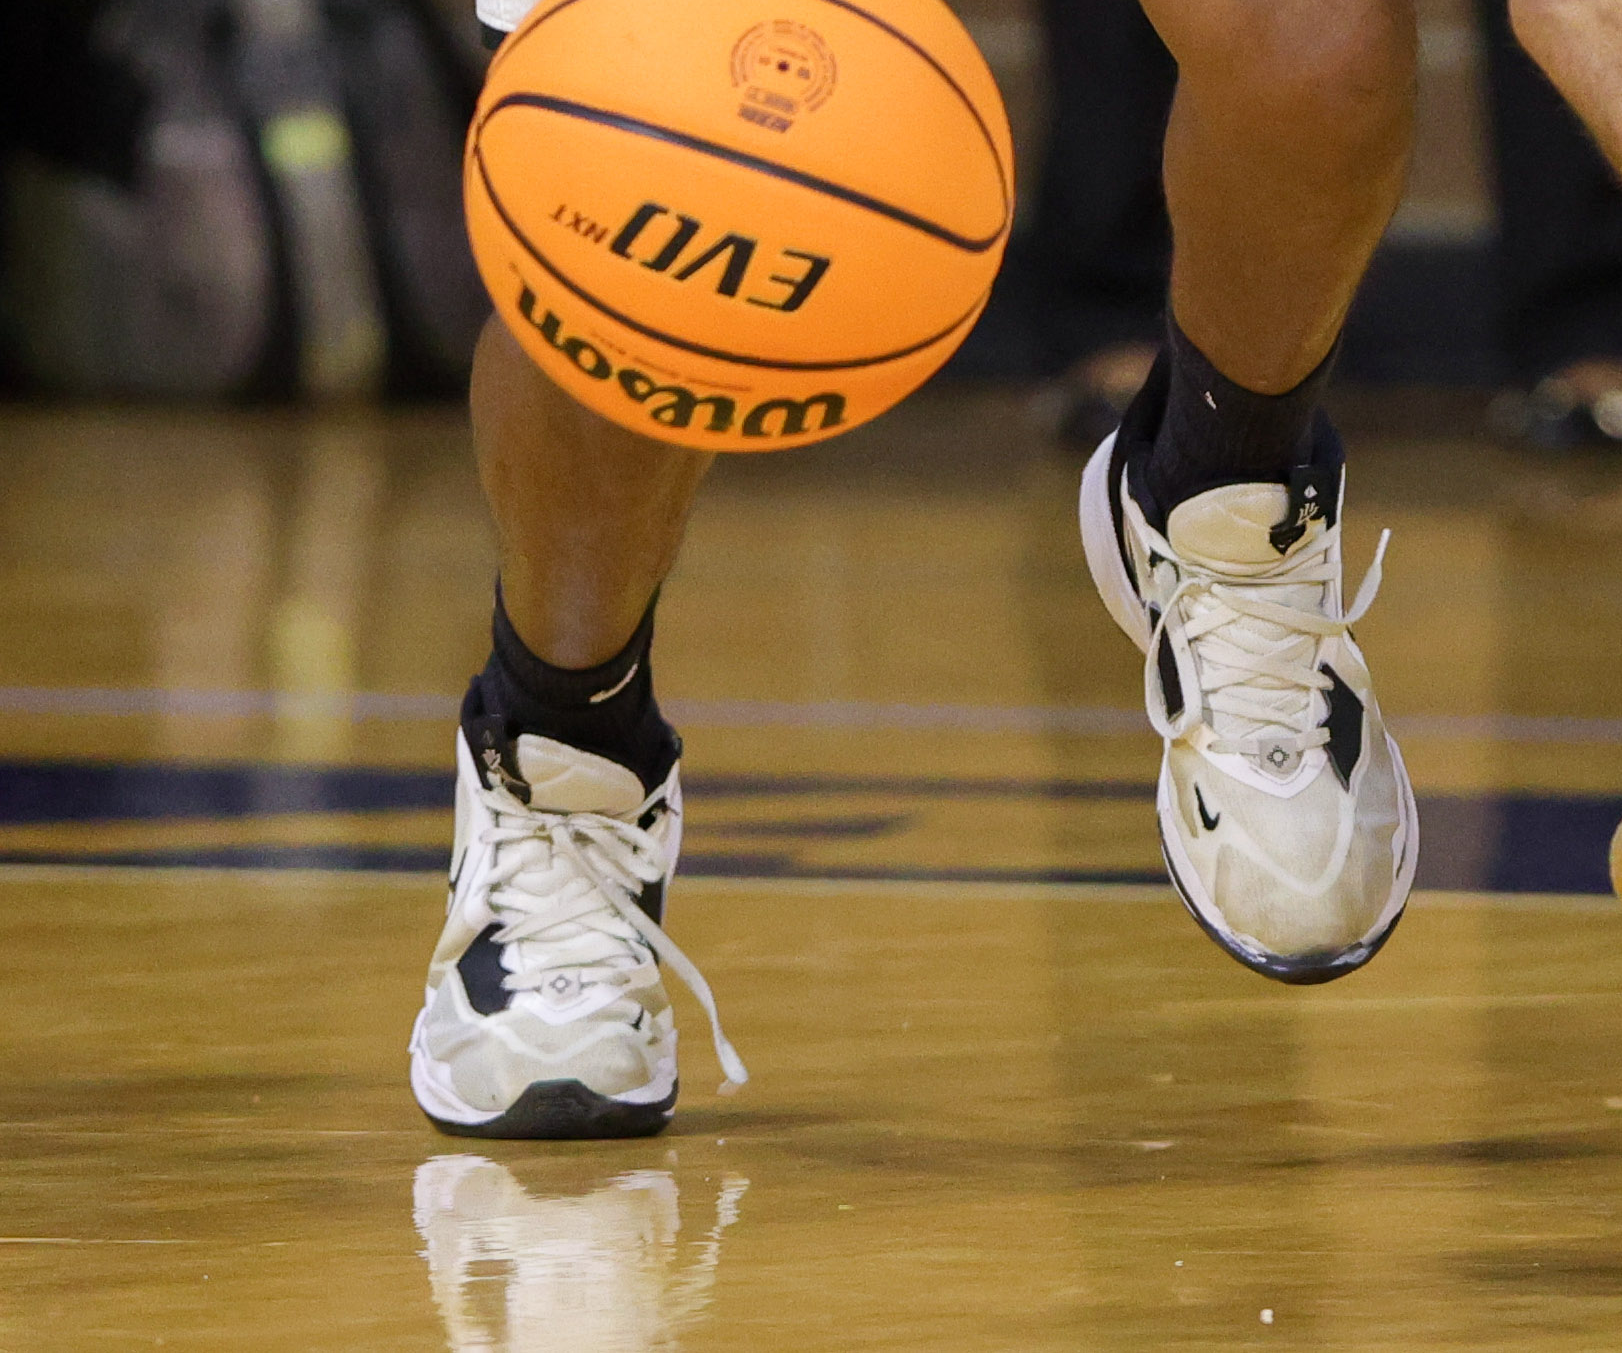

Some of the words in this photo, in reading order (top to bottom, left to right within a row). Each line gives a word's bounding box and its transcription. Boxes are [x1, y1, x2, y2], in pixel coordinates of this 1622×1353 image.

[548, 202, 608, 245] NXT
[608, 201, 831, 313] EVO
[516, 284, 848, 440] Wilson
